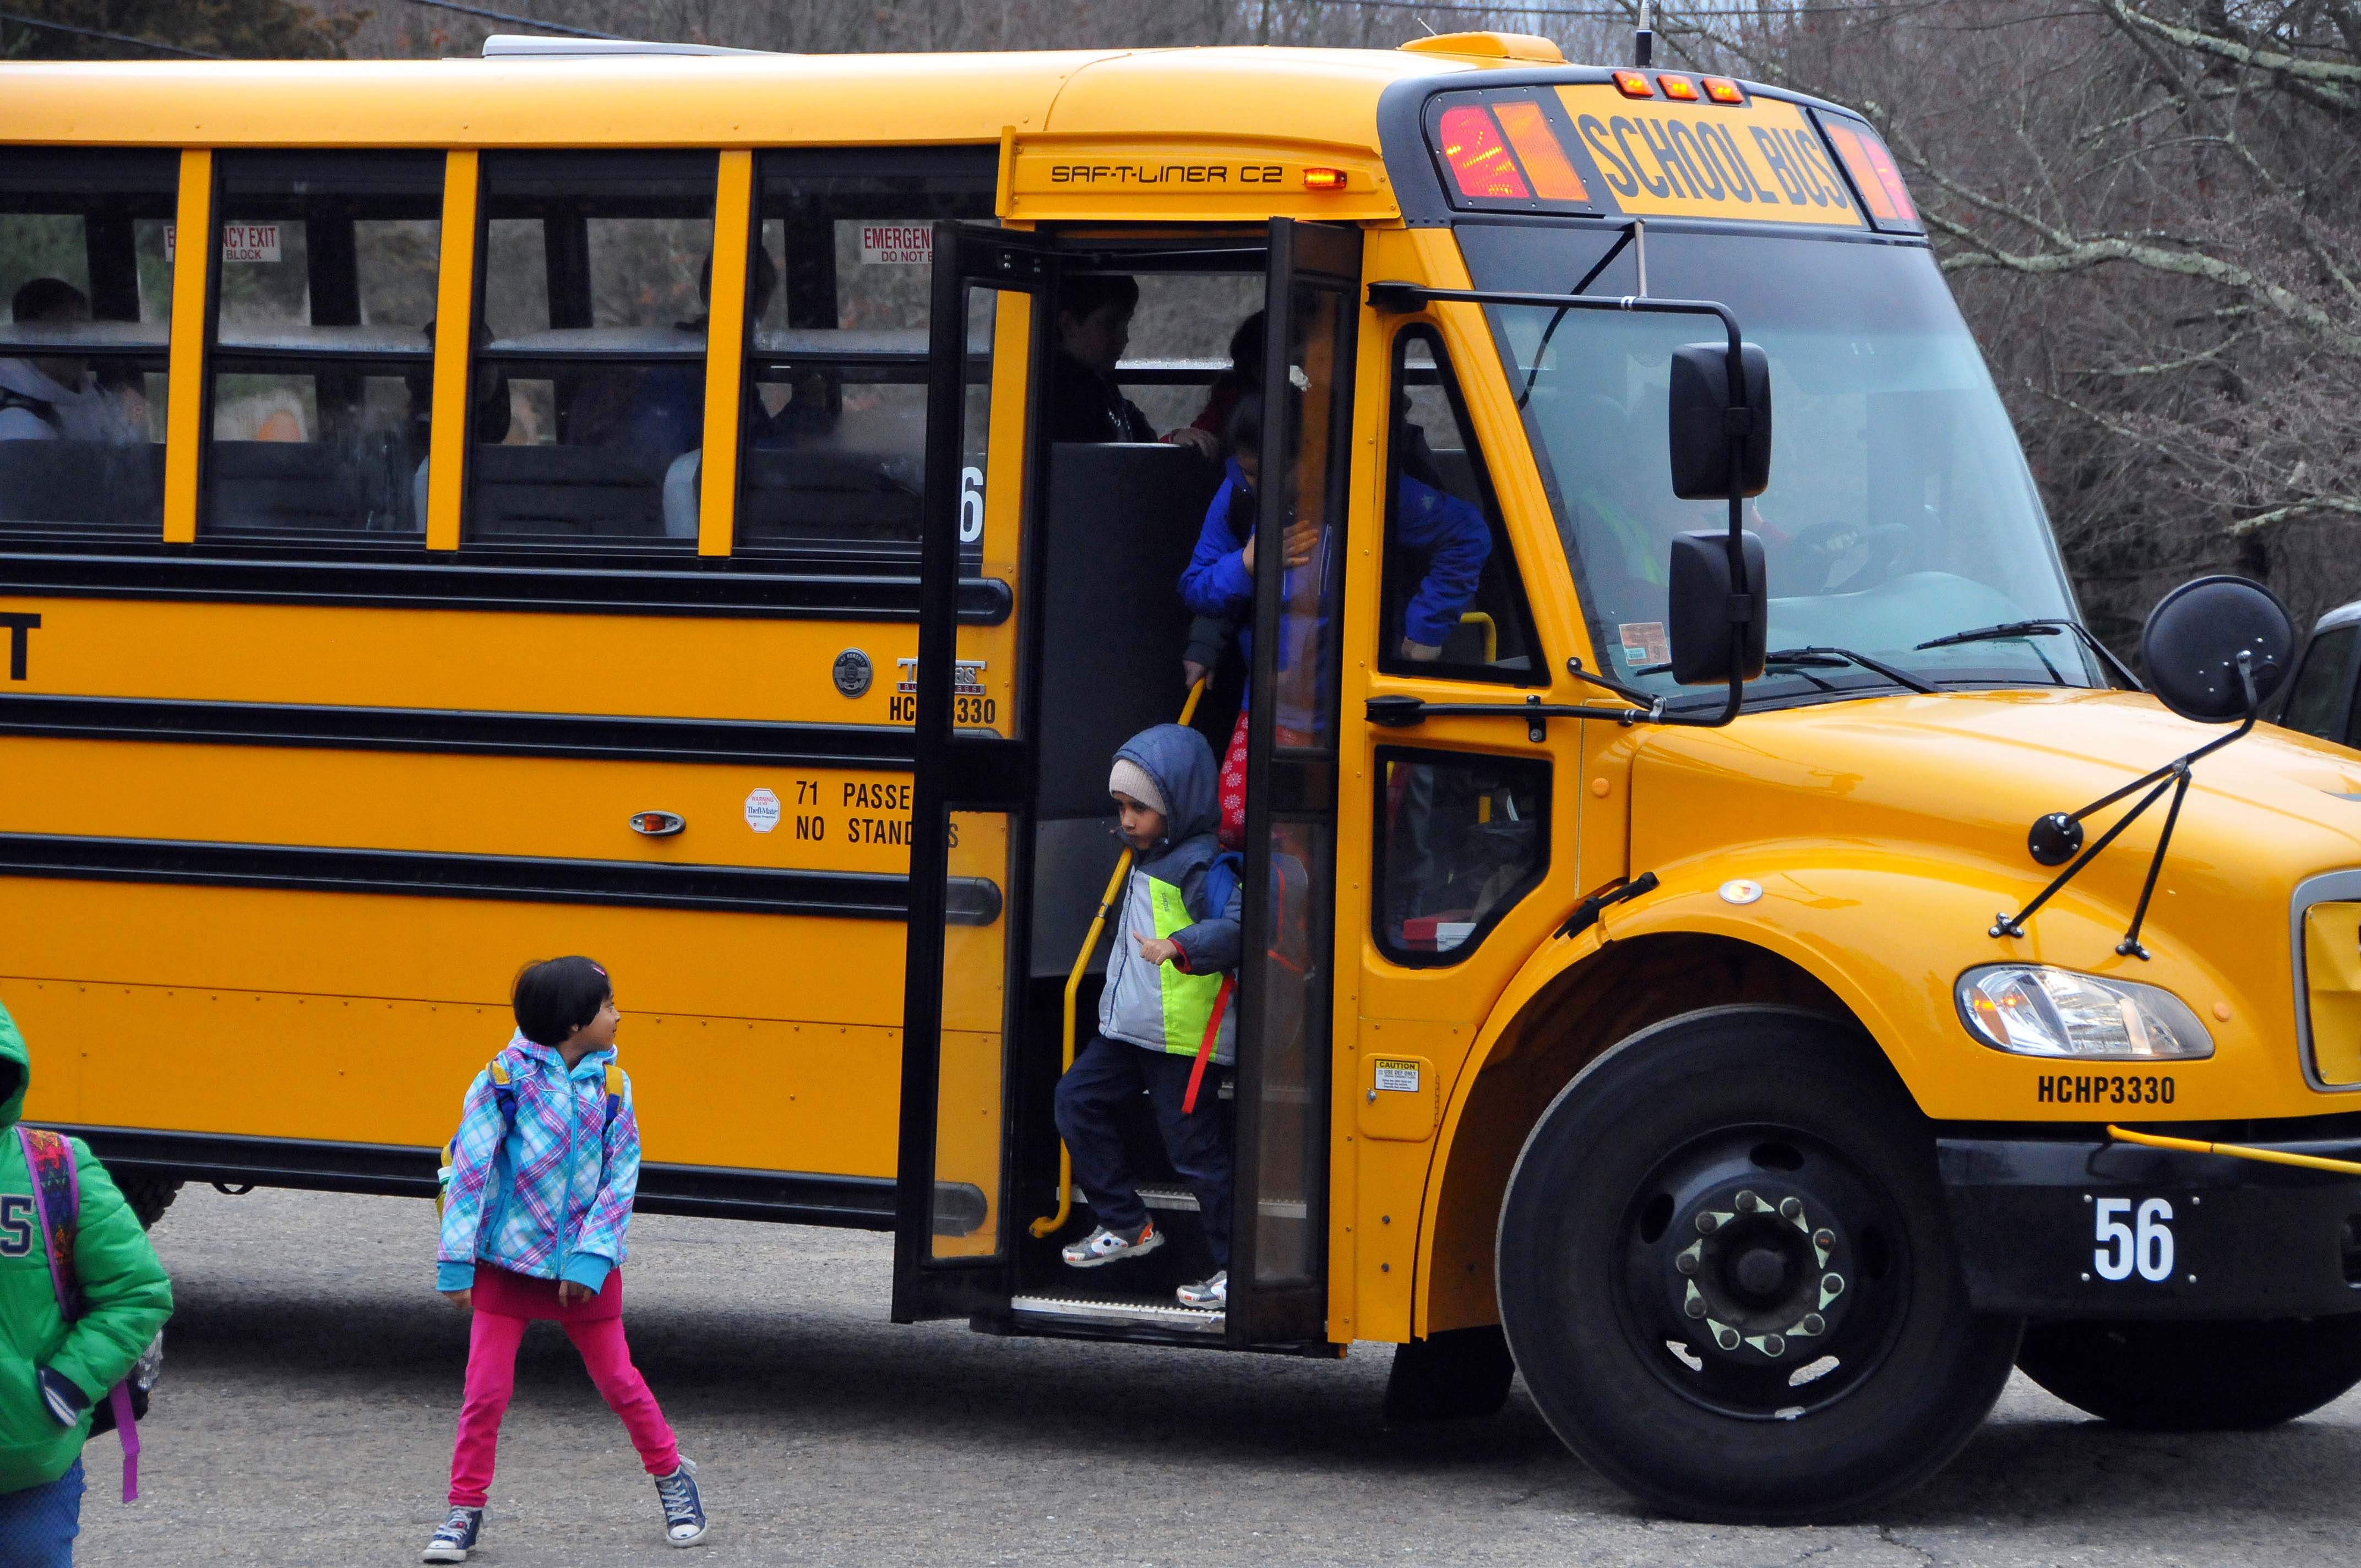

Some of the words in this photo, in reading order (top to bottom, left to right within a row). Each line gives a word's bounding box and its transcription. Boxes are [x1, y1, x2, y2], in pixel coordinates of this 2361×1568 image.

[1577, 113, 1780, 204] SCHOOL
[1747, 126, 1848, 209] BUS
[1051, 166, 1227, 183] SAF-T-LINER
[1240, 166, 1283, 182] C2
[248, 227, 275, 247] EXIT
[864, 228, 932, 249] EMERGEN
[226, 249, 262, 260] BLOCK
[882, 251, 897, 262] DO
[901, 251, 923, 262] NOT
[0, 612, 41, 680] T
[890, 696, 995, 723] HC330
[796, 781, 818, 805] 71
[844, 782, 911, 810] PASSE
[796, 815, 824, 841] NO
[1379, 1061, 1415, 1070] CAUTION
[2038, 1075, 2175, 1104] HCHP3330
[2095, 1197, 2174, 1282] 56
